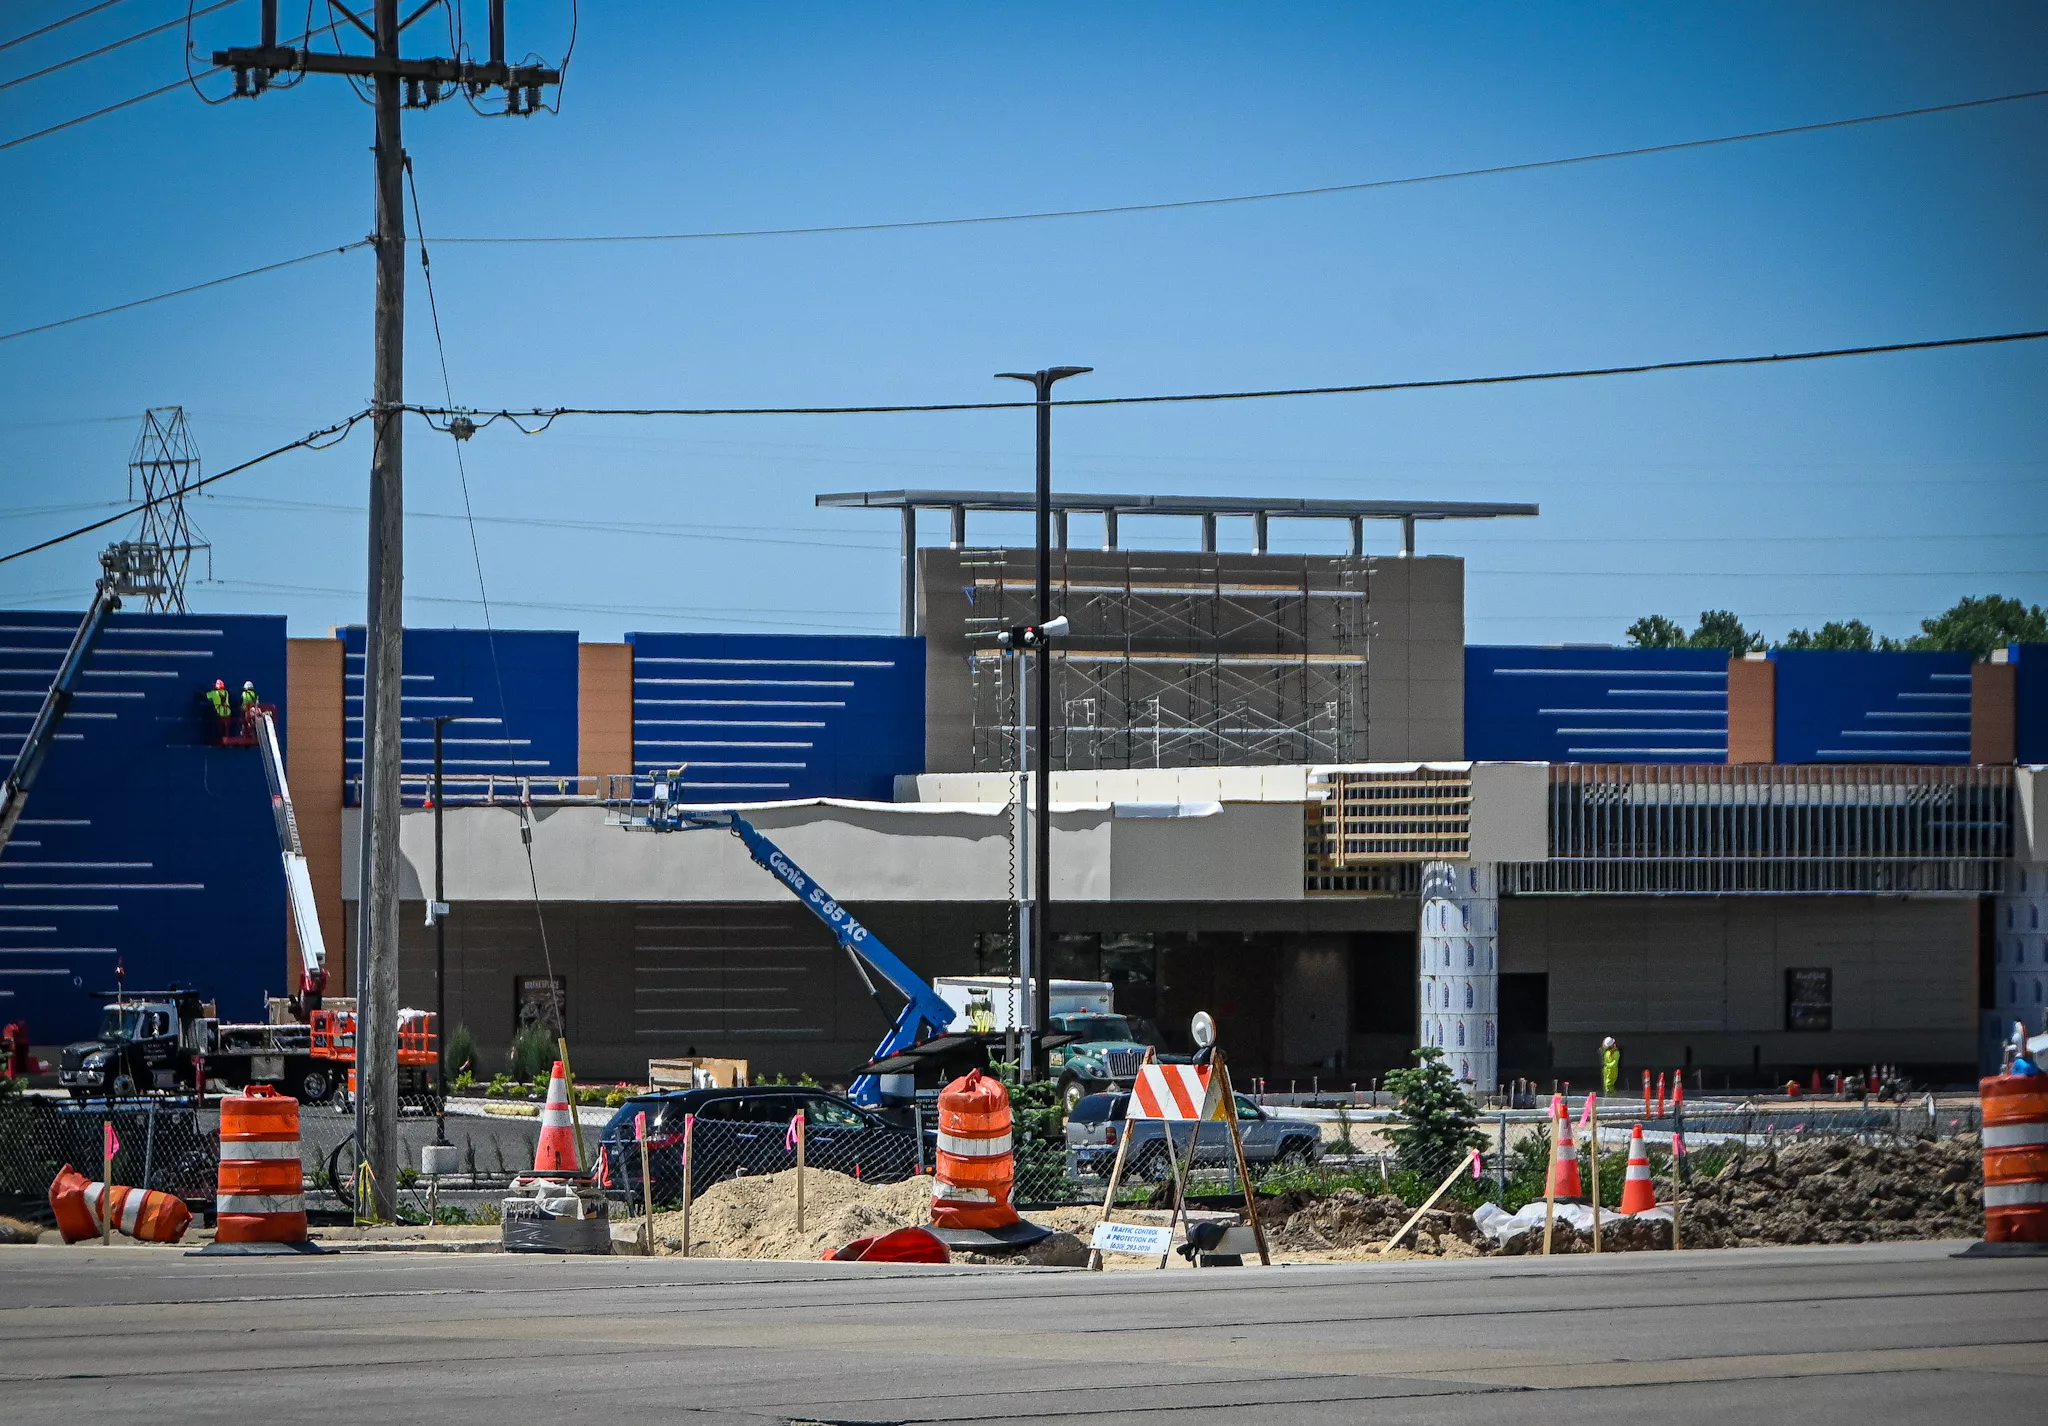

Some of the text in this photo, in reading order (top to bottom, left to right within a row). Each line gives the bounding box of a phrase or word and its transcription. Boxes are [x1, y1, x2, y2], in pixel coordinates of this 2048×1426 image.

[770, 851, 868, 941] Genie S-65 XC
[1111, 1225, 1159, 1236] TRAFFIC CONTROL
[1111, 1235, 1148, 1243] PROTECTION
